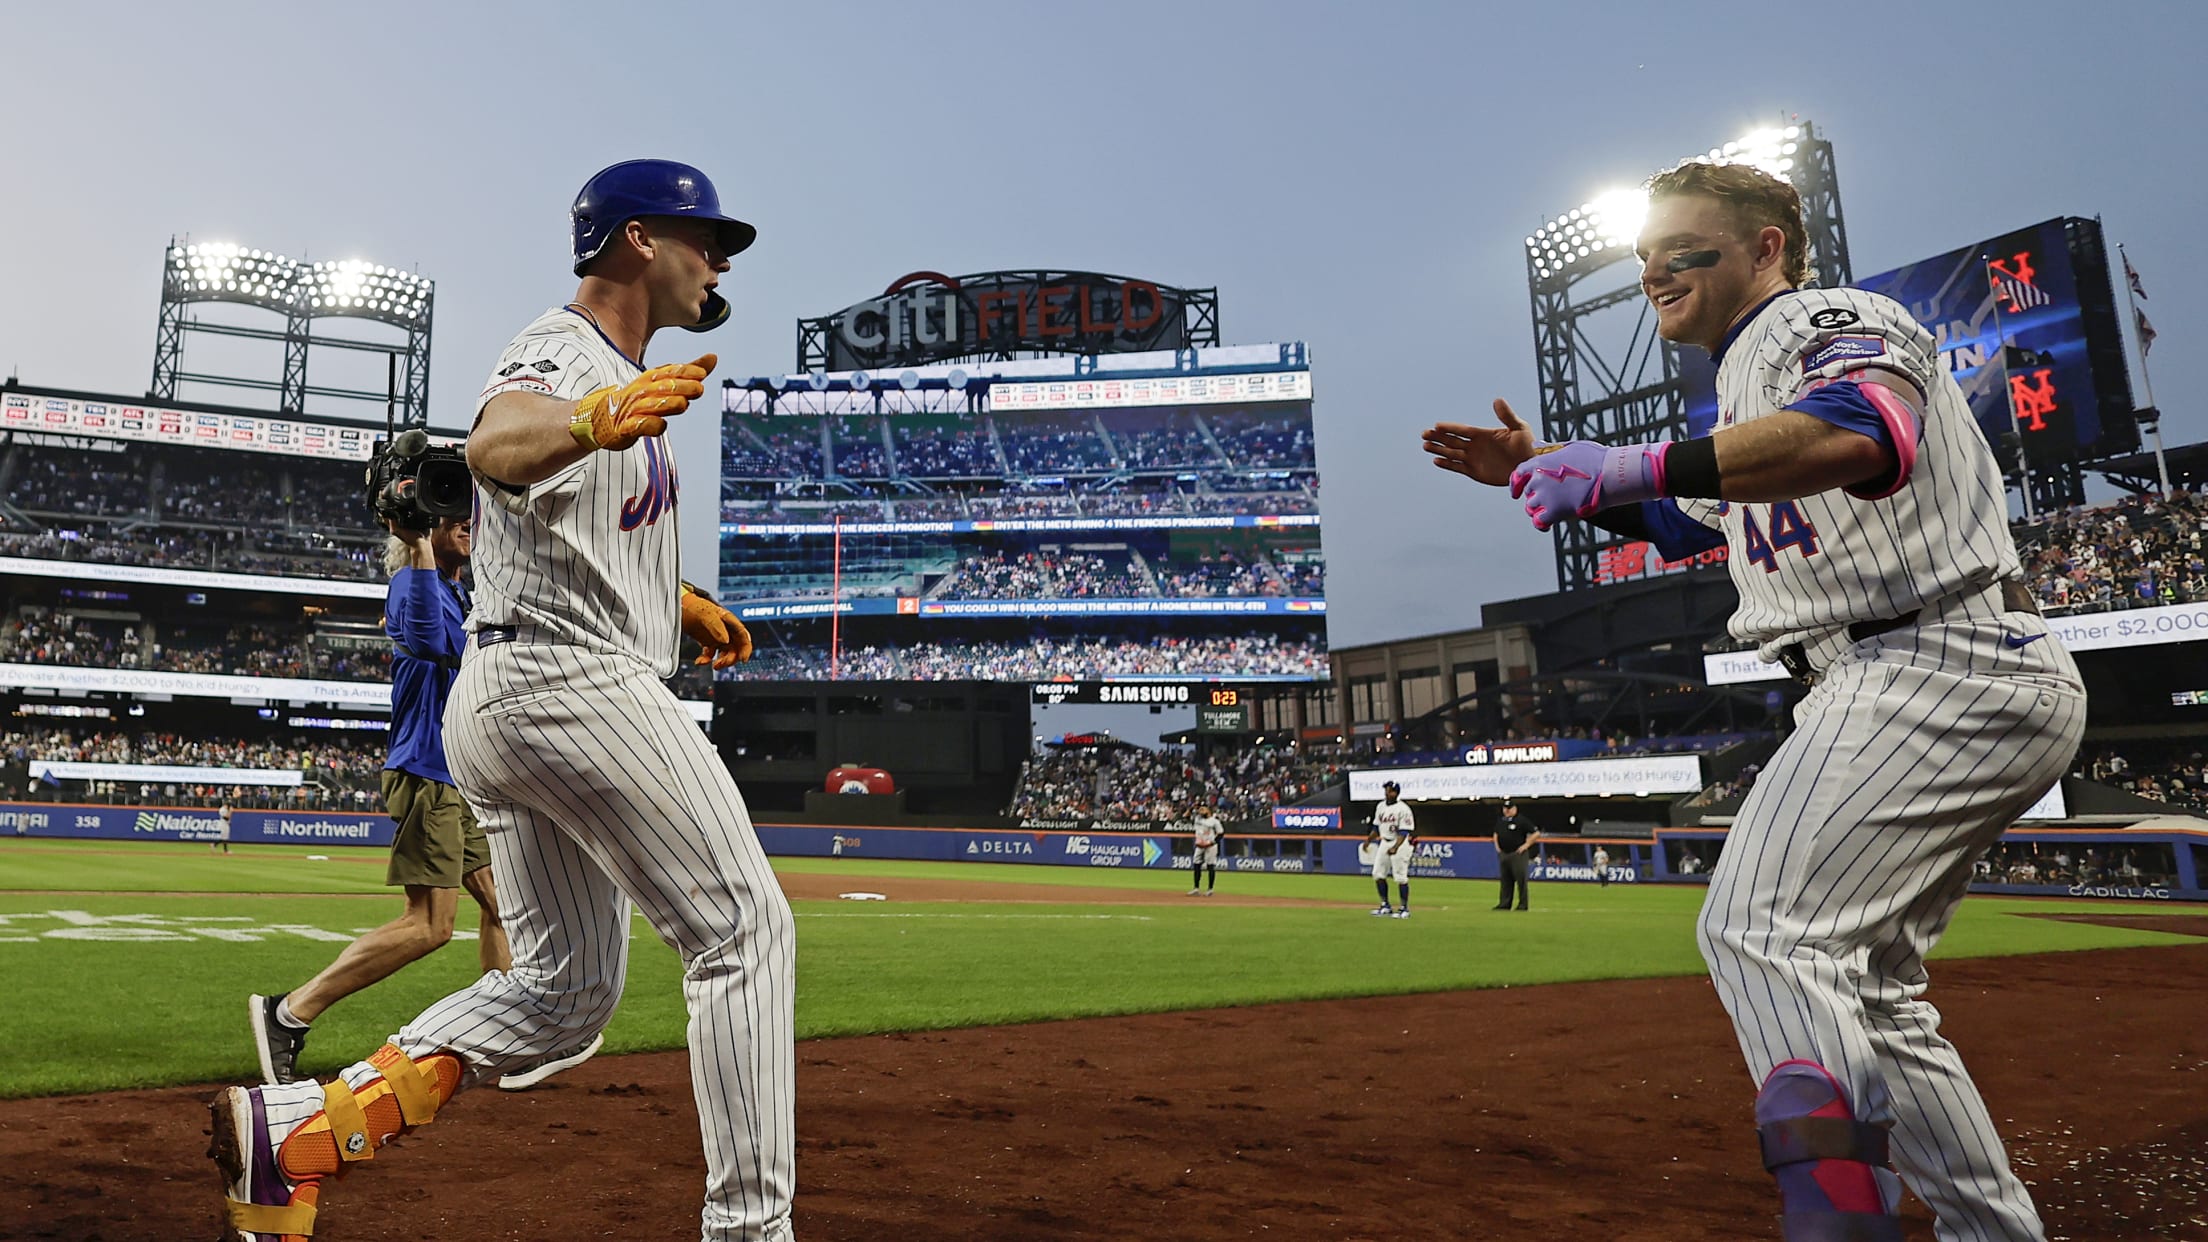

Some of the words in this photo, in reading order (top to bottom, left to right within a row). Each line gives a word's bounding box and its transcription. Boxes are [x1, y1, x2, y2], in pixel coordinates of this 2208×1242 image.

[843, 284, 957, 349] citi
[977, 281, 1164, 340] FIELD
[1816, 311, 1853, 327] 24
[895, 522, 954, 532] PROMOTION
[1026, 520, 1045, 530] THE
[1046, 520, 1072, 530] METS
[1072, 519, 1106, 529] SWING
[1114, 518, 1133, 528] THE
[1134, 518, 1172, 528] FENCES
[1172, 517, 1234, 528] PROMOTION
[1278, 516, 1313, 526] ENTER
[1743, 499, 1820, 574] 44
[904, 600, 914, 612] 2
[944, 604, 964, 613] YOU
[965, 604, 998, 612] COULD
[998, 603, 1019, 612] WIN
[1058, 602, 1087, 612] WHEN
[1088, 602, 1106, 611] THE
[1106, 602, 1133, 611] METS
[1134, 602, 1150, 611] HIT
[1150, 602, 1160, 611] A
[1160, 602, 1190, 610] HOME
[1225, 602, 1244, 610] THE
[2117, 612, 2208, 637] $2,000
[327, 638, 352, 648] THE
[313, 685, 348, 697] That's
[1064, 684, 1079, 694] PM
[1100, 686, 1188, 702] SAMSUNG
[1064, 732, 1094, 744] Coors
[1465, 748, 1488, 764] citi
[1493, 746, 1553, 763] PAVILION
[1543, 772, 1584, 785] $2,000
[74, 816, 101, 828] 358
[156, 814, 221, 831] Nationa
[1030, 818, 1055, 828] Coors
[1055, 820, 1078, 829] LIGHT
[1102, 819, 1127, 830] Coors
[1127, 822, 1150, 830] LIGHT
[280, 820, 369, 838] Northwell
[983, 841, 1032, 854] DELTA
[1090, 846, 1140, 857] HAUGLAND
[1090, 856, 1122, 866] GROUP
[1172, 856, 1192, 869] 380
[1236, 858, 1265, 870] GOYA
[1273, 859, 1304, 871] GOYA
[1607, 868, 1635, 881] 370
[2068, 885, 2170, 899] CADILLAC
